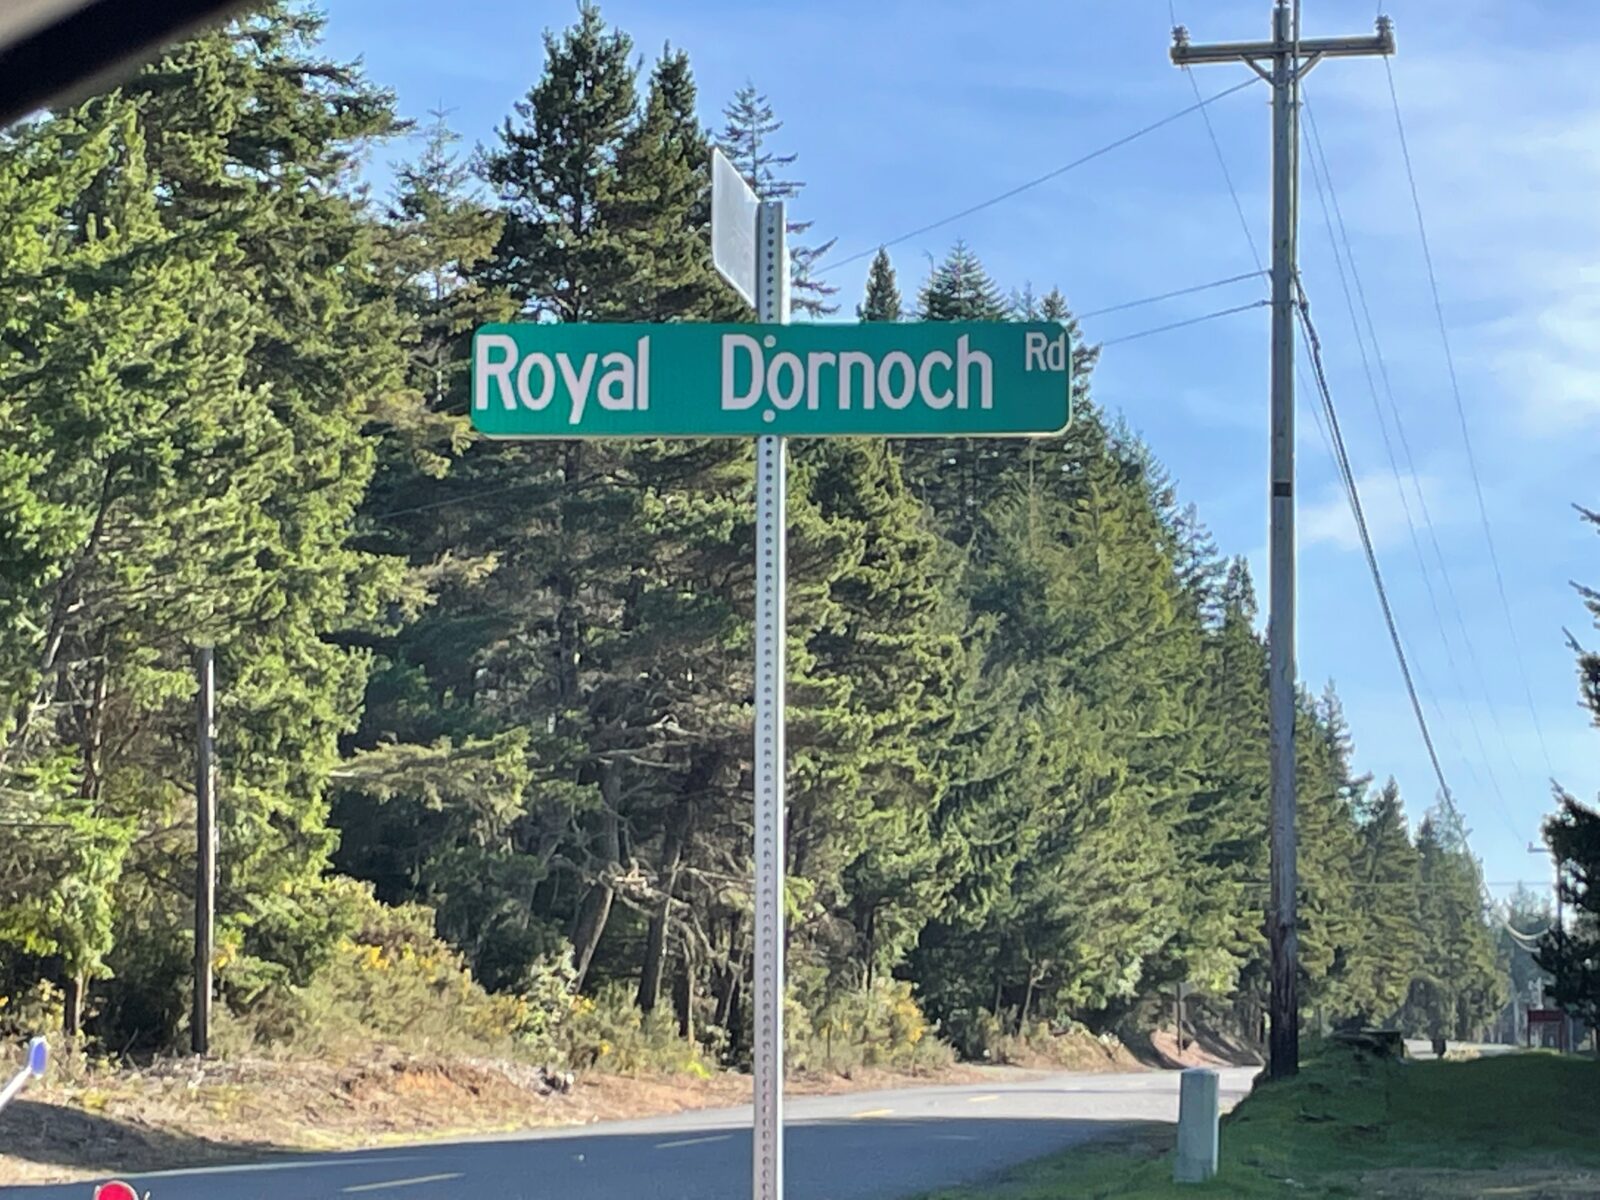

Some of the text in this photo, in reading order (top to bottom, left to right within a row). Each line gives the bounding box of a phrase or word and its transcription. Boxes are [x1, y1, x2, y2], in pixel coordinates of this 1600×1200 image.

[474, 332, 1066, 424] Royal Dornoch Rd
